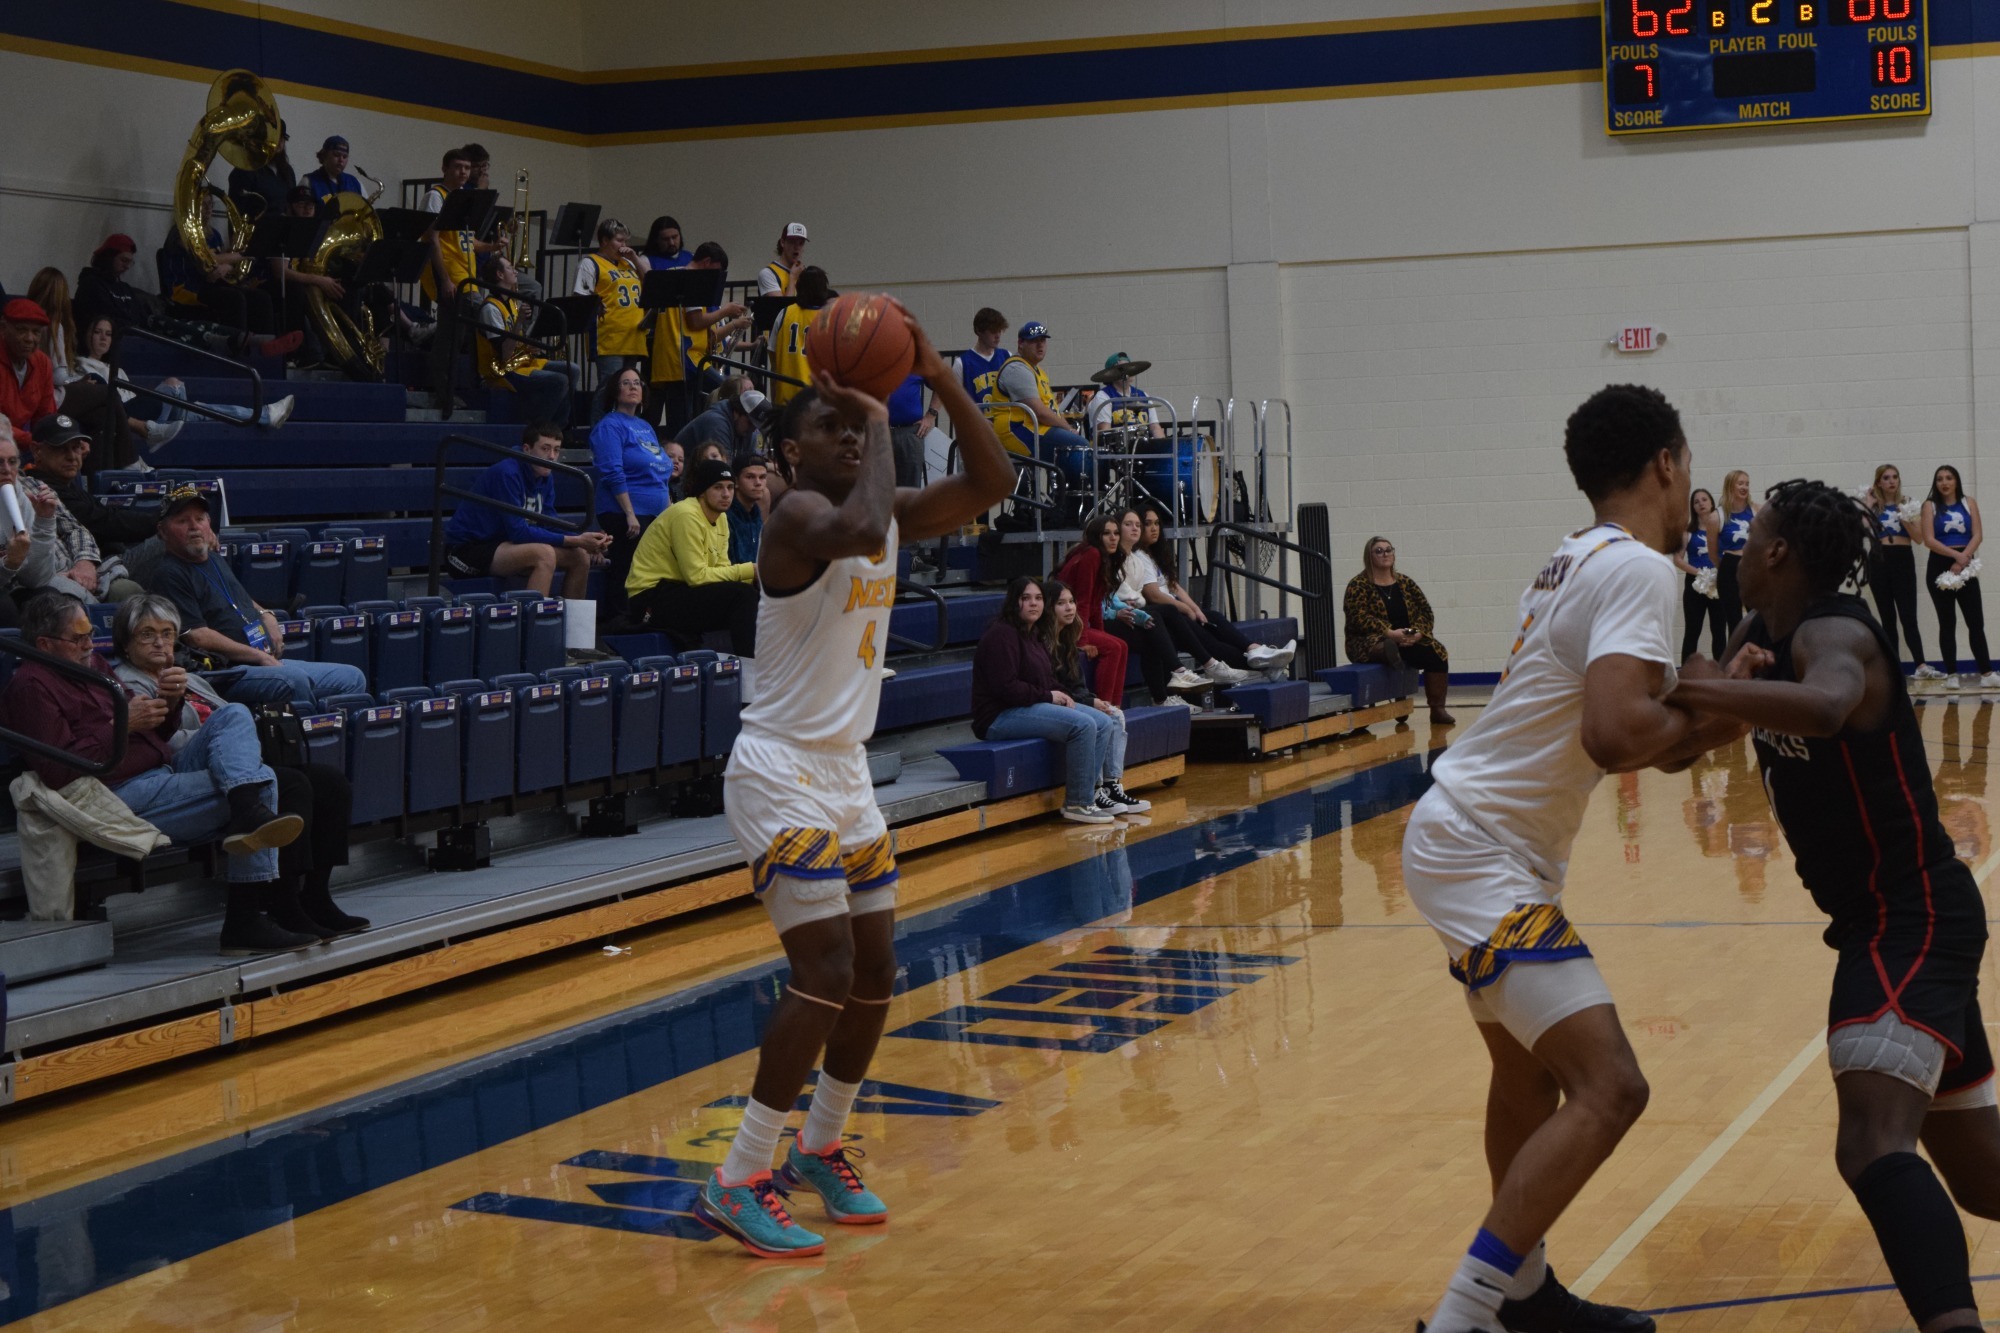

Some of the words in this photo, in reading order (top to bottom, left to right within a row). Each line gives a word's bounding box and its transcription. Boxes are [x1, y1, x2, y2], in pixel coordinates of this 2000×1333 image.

[1632, 0, 1691, 37] 62
[1712, 11, 1725, 28] B
[1800, 4, 1814, 21] B
[1710, 36, 1766, 54] PLAYER
[1778, 32, 1818, 49] FOUL
[1868, 25, 1917, 43] FOULS
[1611, 43, 1659, 61] FOULS
[1877, 46, 1911, 84] 10
[1634, 64, 1653, 97] 7
[1739, 101, 1791, 119] MATCH
[1870, 92, 1921, 111] SCORE
[1614, 109, 1663, 127] SCORE
[618, 284, 642, 308] 33
[1624, 327, 1652, 350] EXIT
[972, 370, 999, 395] NE
[843, 574, 896, 614] NEO
[857, 620, 877, 670] 4
